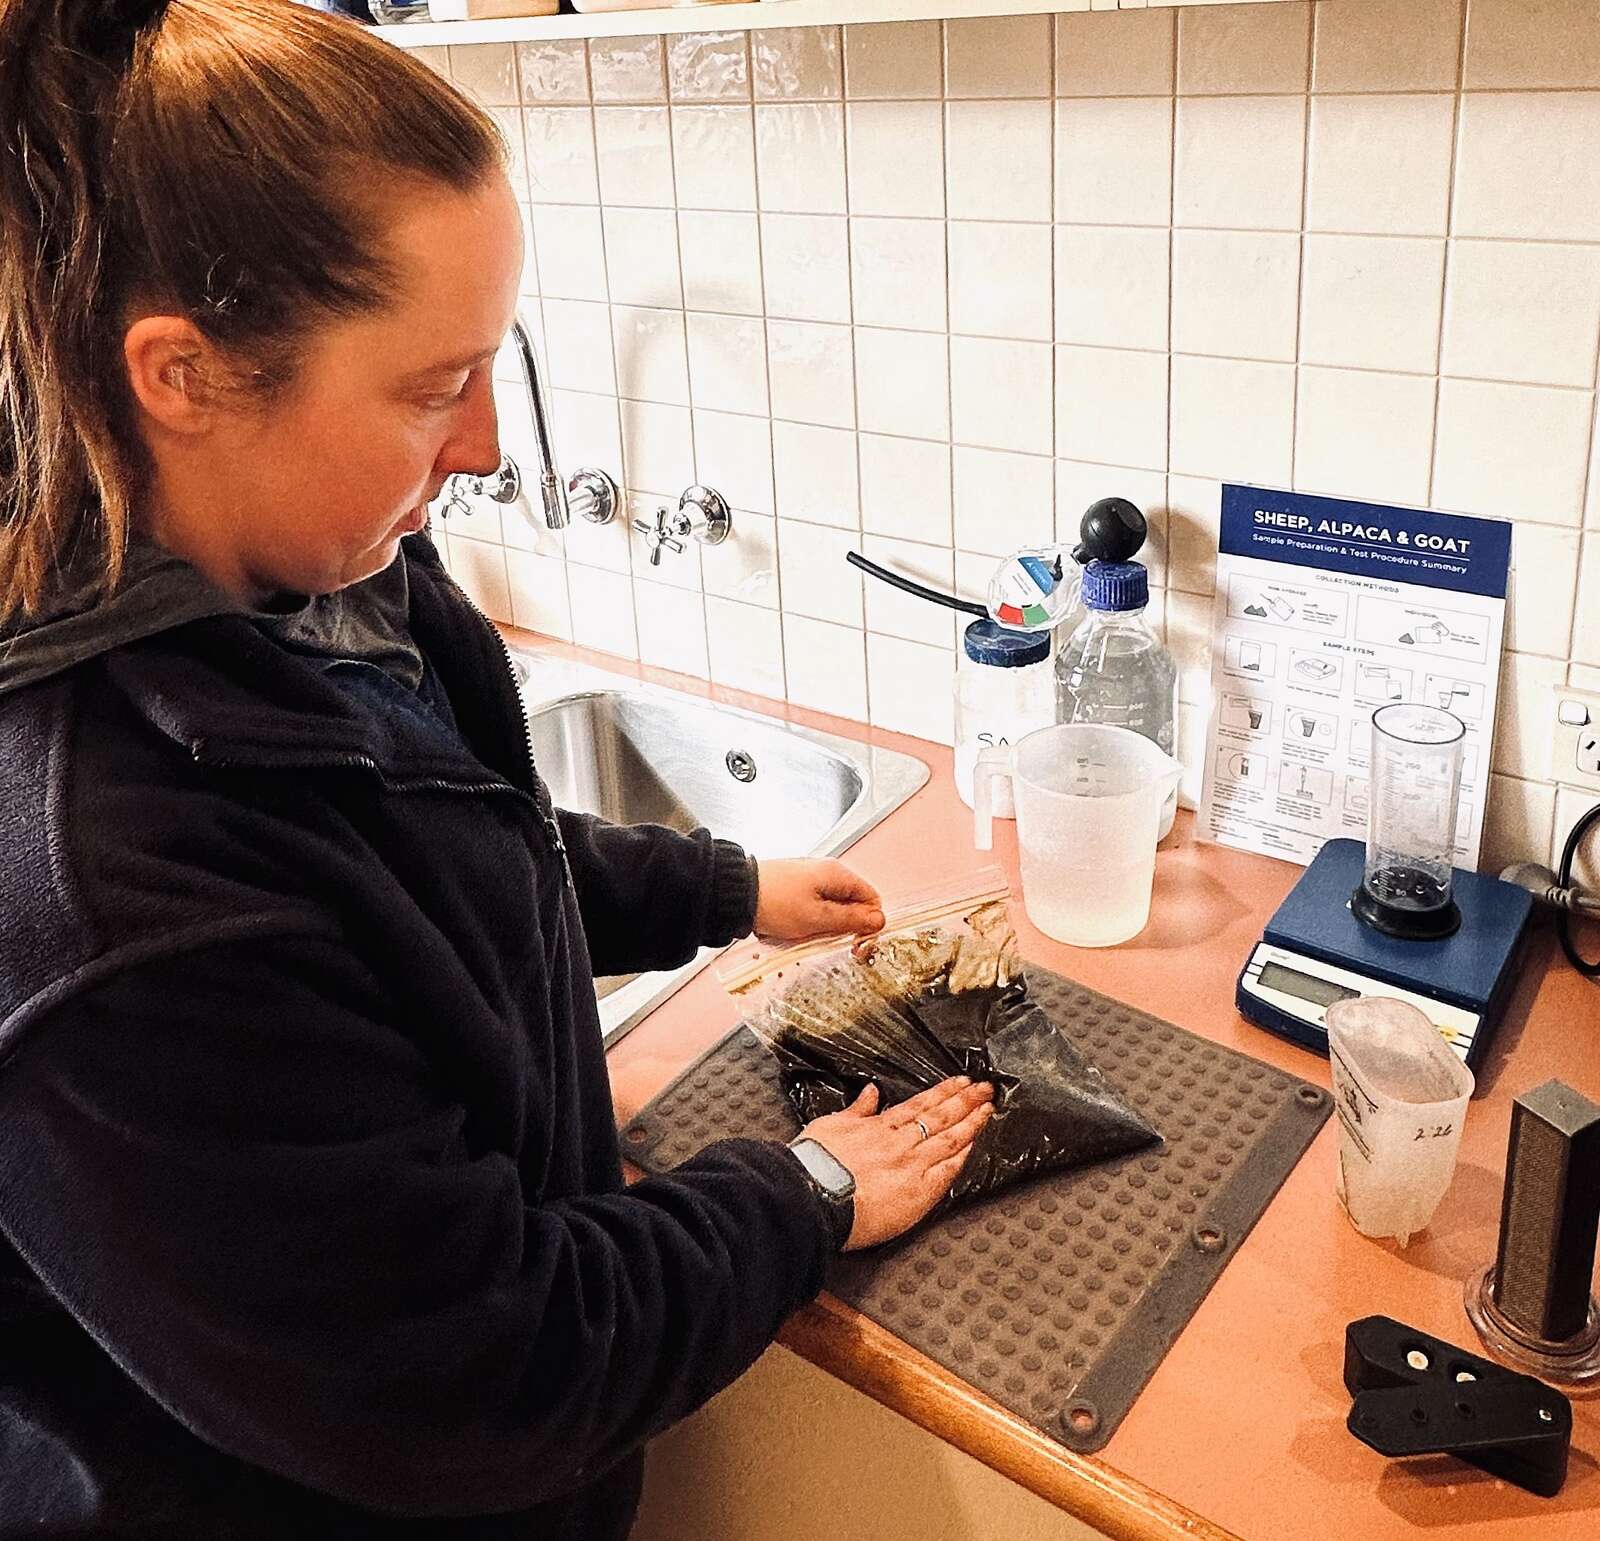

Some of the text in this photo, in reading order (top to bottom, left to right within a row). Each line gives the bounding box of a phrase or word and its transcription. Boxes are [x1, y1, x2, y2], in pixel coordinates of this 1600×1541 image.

[1253, 510, 1471, 554] SHEEP, ALPACA & GOAT
[1252, 533, 1468, 575] Sample Preparation & Test Procedure Summary
[1315, 573, 1399, 593] COLLECTION METHODS
